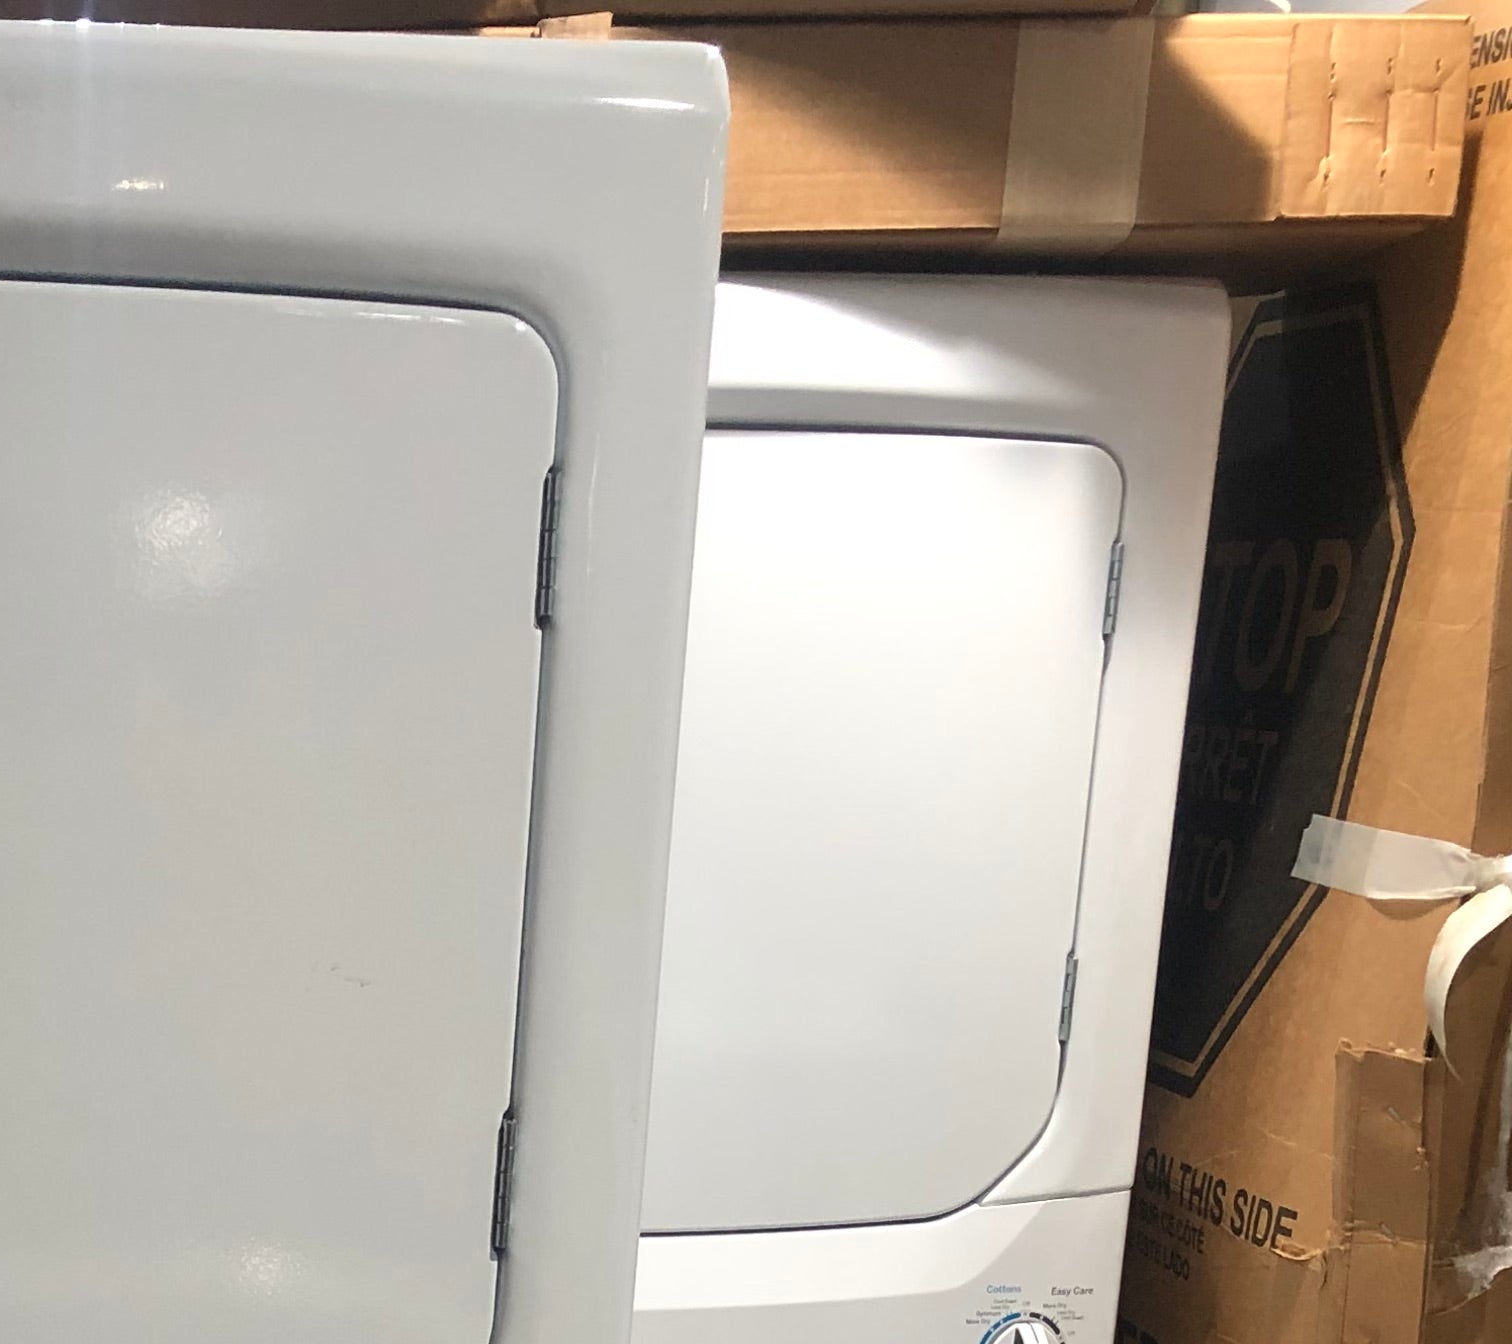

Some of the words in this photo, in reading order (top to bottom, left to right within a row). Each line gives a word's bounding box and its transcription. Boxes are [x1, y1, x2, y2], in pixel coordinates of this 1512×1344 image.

[1143, 1147, 1173, 1200] ON
[1179, 1163, 1226, 1226] THIS
[1231, 1189, 1298, 1252] SIDE
[986, 1285, 1021, 1294] Cottons
[1051, 1287, 1071, 1297] Easy
[1073, 1286, 1094, 1295] Care
